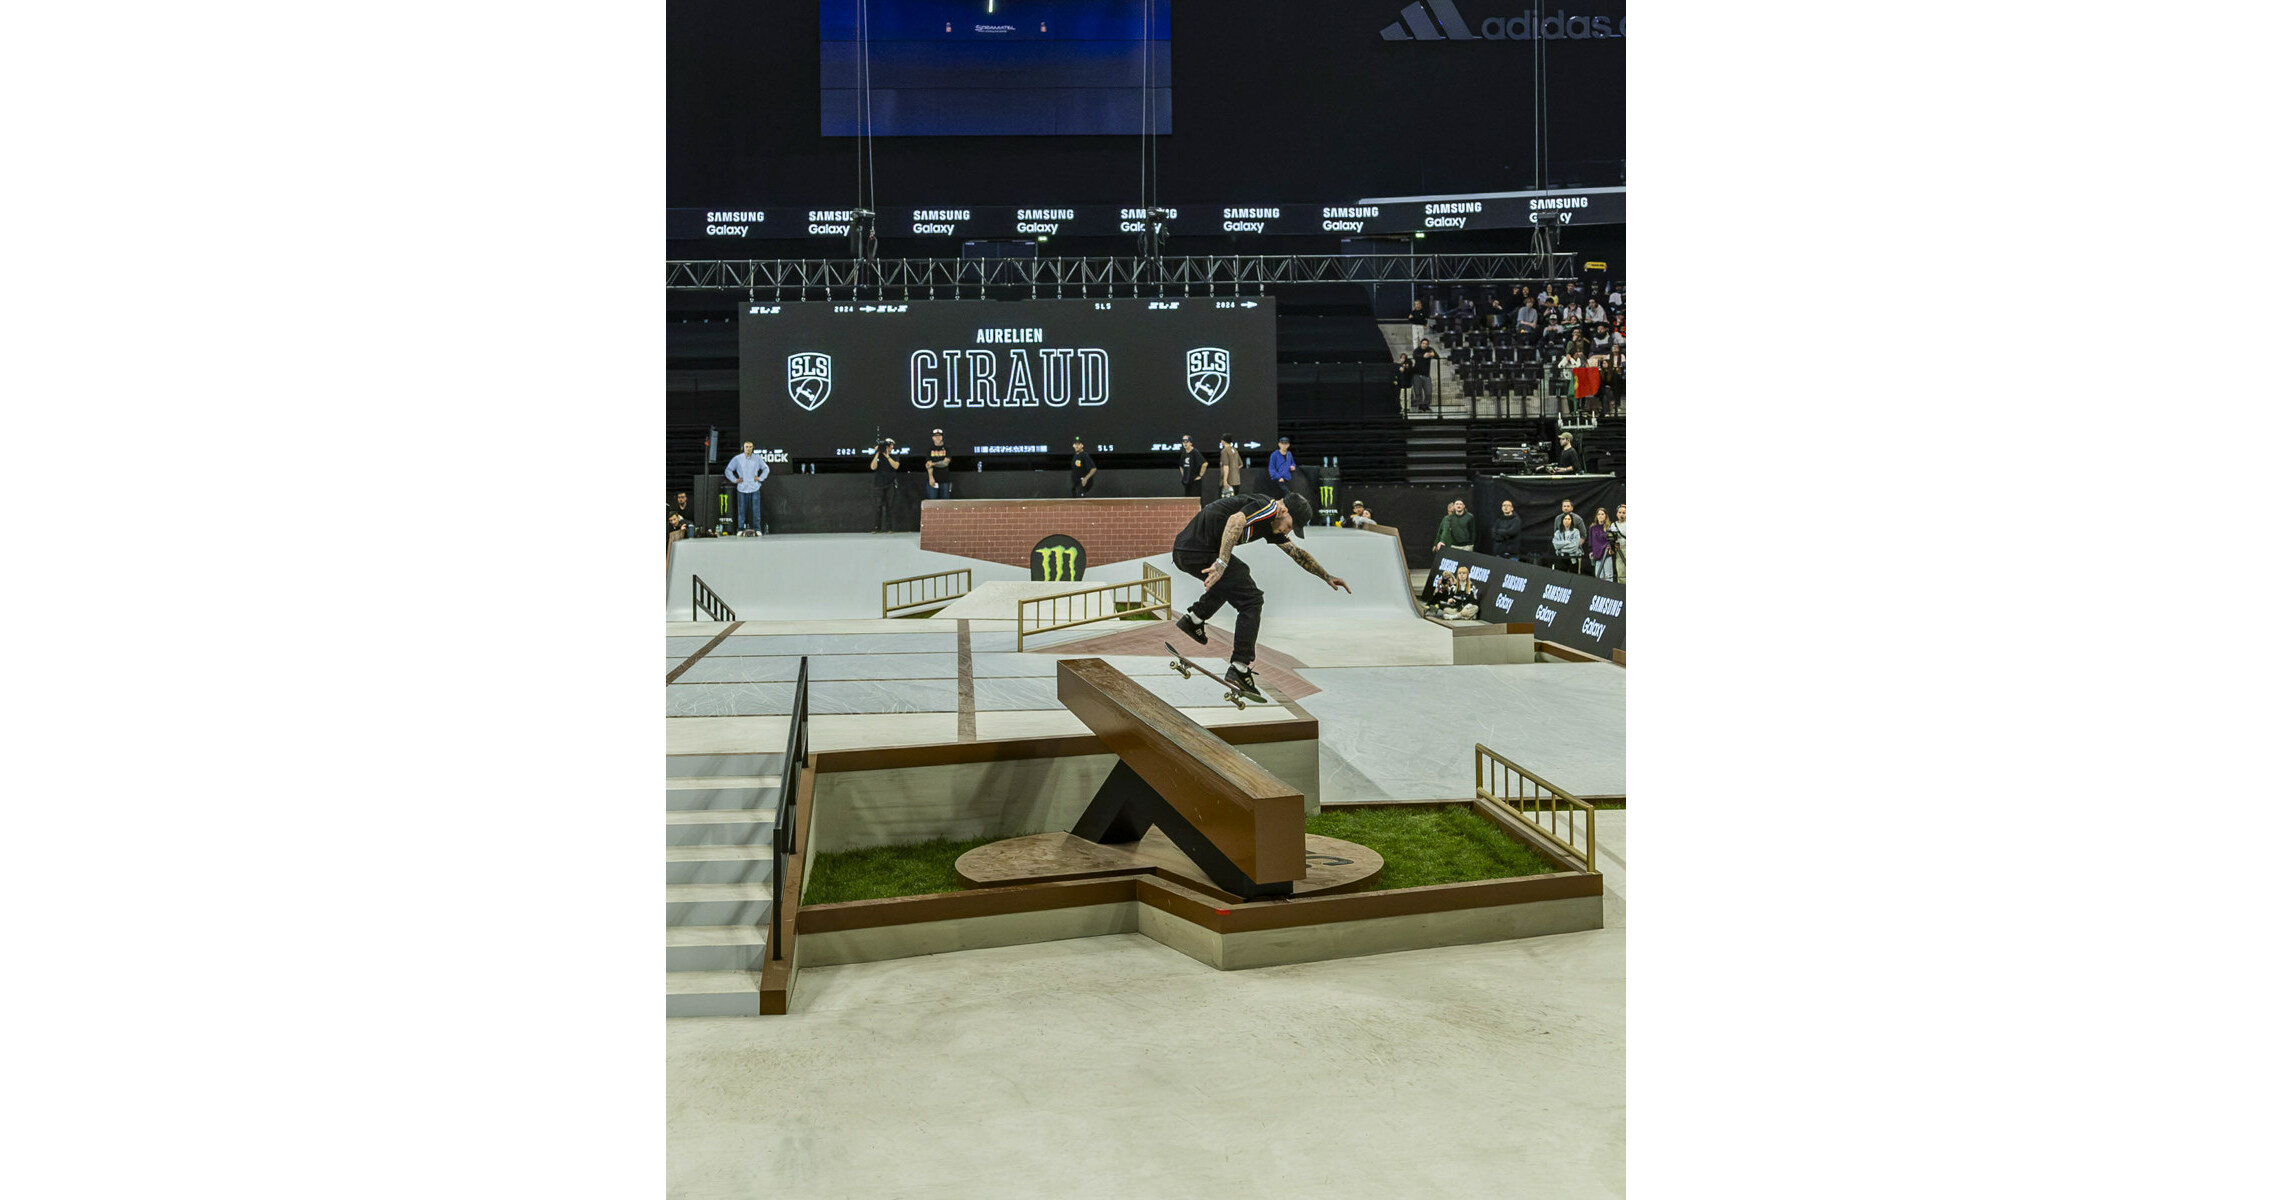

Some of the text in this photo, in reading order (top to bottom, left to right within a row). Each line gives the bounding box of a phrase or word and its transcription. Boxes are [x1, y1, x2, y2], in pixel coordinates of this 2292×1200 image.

[1481, 10, 1612, 40] adidas
[1424, 202, 1482, 214] SAMSUNG
[1529, 197, 1588, 210] SAMSUNG
[706, 211, 765, 222] SAMSUNG
[808, 210, 853, 221] SAMSU
[913, 210, 971, 221] SAMSUNG
[1017, 209, 1074, 220] SAMSUNG
[1223, 208, 1280, 219] SAMSUNG
[1322, 206, 1379, 218] SAMSUNG
[1016, 222, 1059, 235] Galaxy
[1223, 220, 1265, 234] Galaxy
[1322, 219, 1364, 233] Galaxy
[1424, 216, 1467, 229] Galaxy
[706, 224, 749, 238] Galaxy
[808, 223, 851, 237] Galaxy
[912, 223, 955, 236] Galaxy
[834, 305, 854, 313] 2024
[1094, 302, 1112, 310] SLS
[1215, 301, 1236, 309] 2024
[976, 327, 1043, 344] AURELIEN
[791, 356, 828, 377] SLS
[1190, 351, 1226, 372] SLS
[910, 347, 1110, 409] GIRAUD
[836, 448, 856, 456] 2024
[1097, 444, 1114, 452] SLS
[1502, 574, 1528, 593] SAMSUNG
[1542, 583, 1572, 605] SAMSUNG
[1589, 594, 1623, 618] SAMSUNG
[1535, 604, 1557, 627] Galaxy
[1581, 617, 1606, 643] Galaxy
